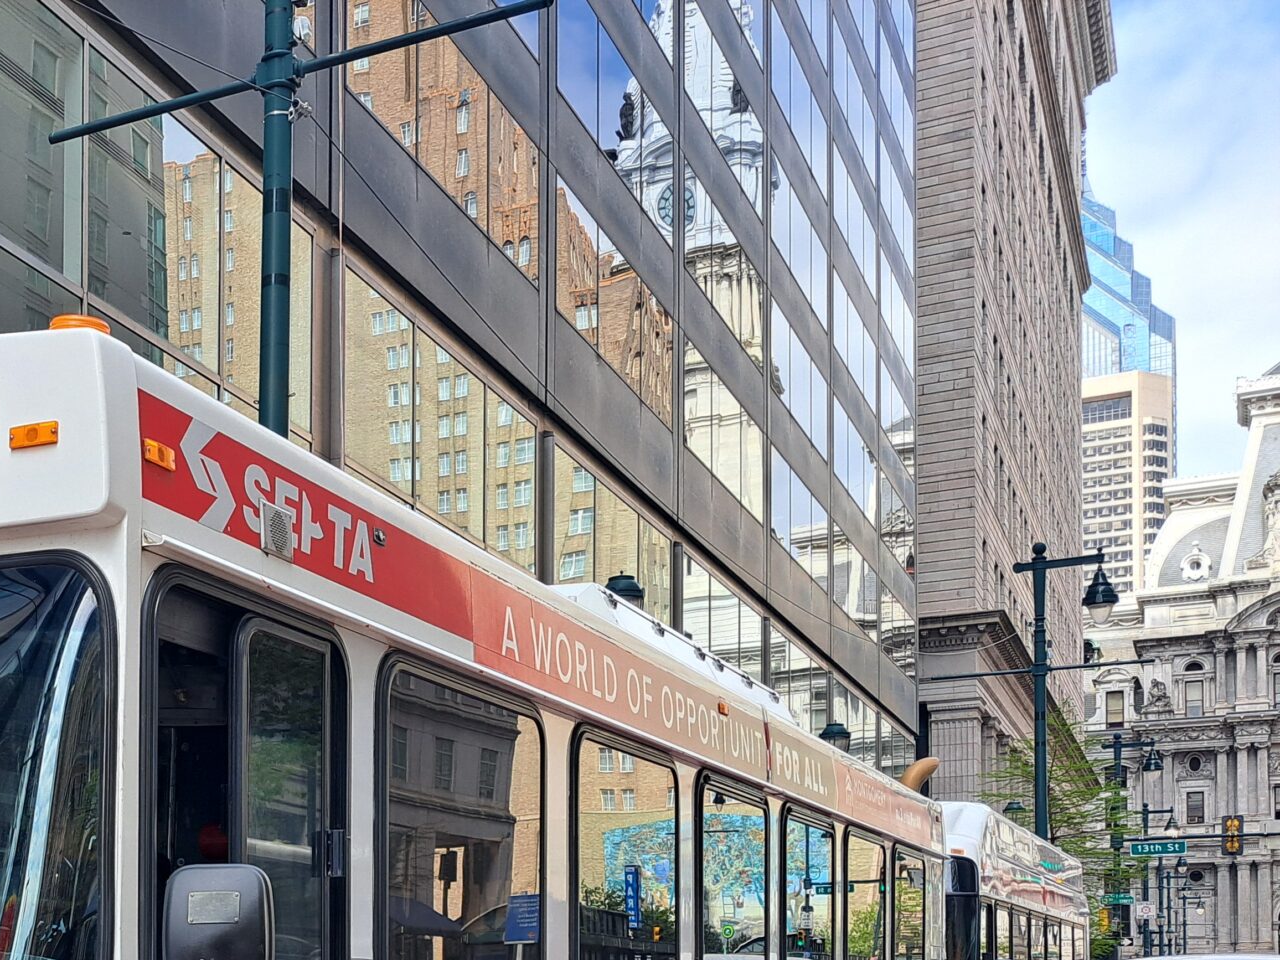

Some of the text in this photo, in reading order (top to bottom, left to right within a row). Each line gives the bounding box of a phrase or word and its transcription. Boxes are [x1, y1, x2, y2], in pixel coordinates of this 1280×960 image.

[501, 605, 829, 797] A WORLD OF OPPORTUNIT FOR ALL.
[1137, 843, 1180, 853] 13th St
